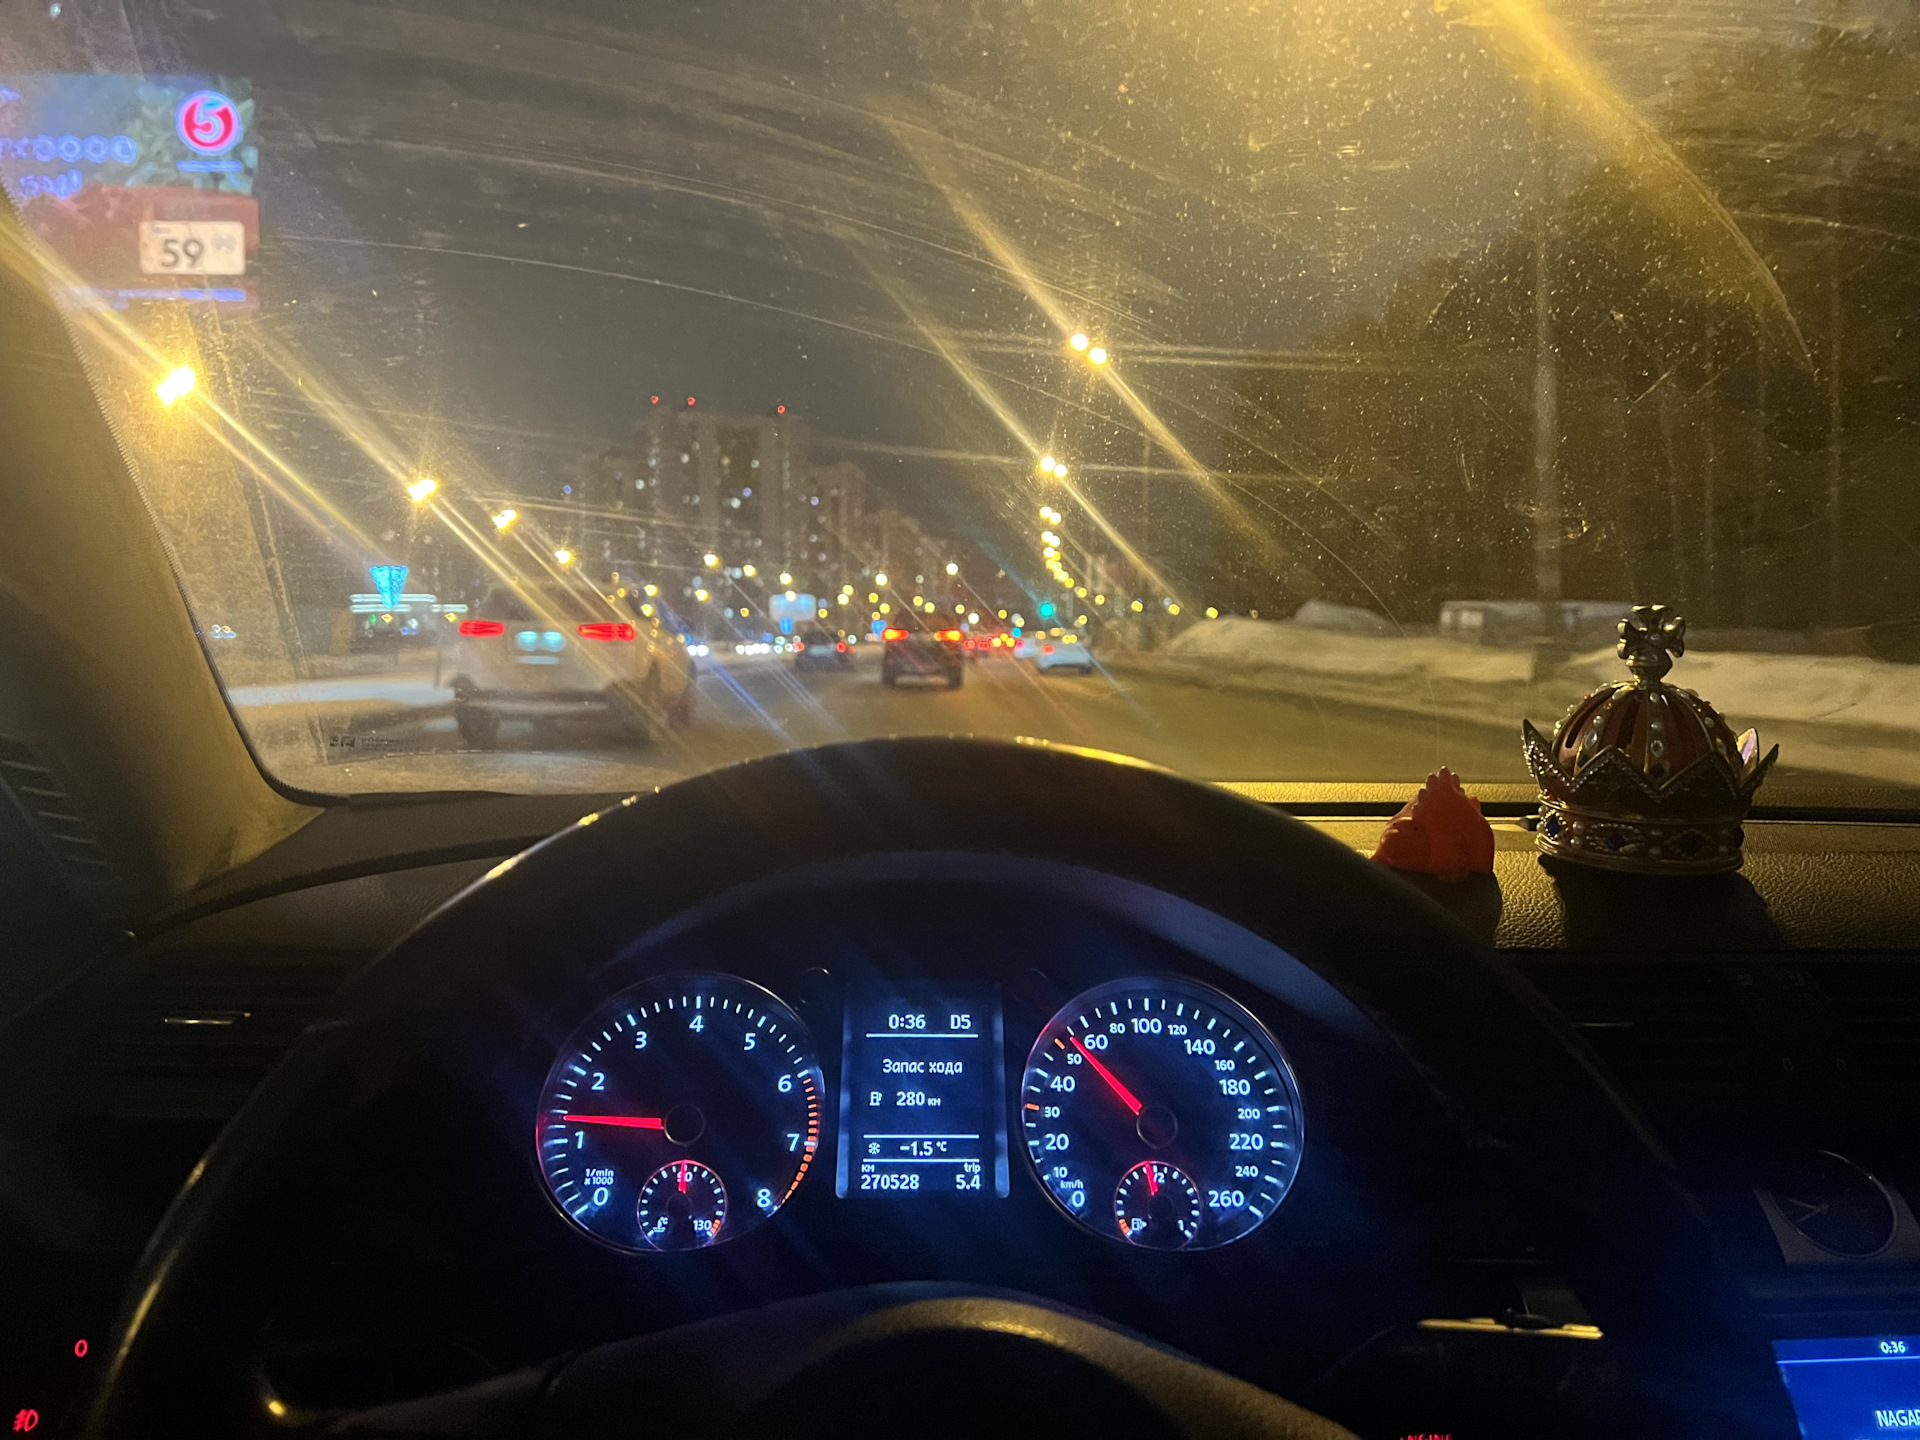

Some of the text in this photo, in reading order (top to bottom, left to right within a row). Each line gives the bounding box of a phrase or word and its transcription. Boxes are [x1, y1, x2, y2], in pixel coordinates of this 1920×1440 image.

[161, 239, 204, 268] 59
[689, 1015, 704, 1033] 4
[888, 1014, 972, 1030] 0:36 D5
[1110, 1022, 1126, 1035] 80
[1131, 1018, 1163, 1034] 100
[1168, 1024, 1188, 1036] 120
[635, 1031, 648, 1050] 3
[744, 1033, 757, 1051] 5
[1084, 1034, 1109, 1051] 60
[1184, 1038, 1216, 1056] 140
[882, 1058, 963, 1075] Запас хода
[1067, 1053, 1083, 1066] 50
[1215, 1060, 1236, 1072] 160
[592, 1072, 605, 1091] 2
[778, 1074, 792, 1093] 6
[1050, 1075, 1076, 1093] 40
[1219, 1079, 1251, 1096] 180
[896, 1091, 926, 1107] 280
[1044, 1106, 1061, 1119] 30
[1237, 1108, 1261, 1120] 200
[575, 1131, 584, 1149] 1
[787, 1133, 800, 1152] 7
[1045, 1133, 1070, 1150] 20
[1229, 1133, 1264, 1151] 220
[584, 1168, 615, 1178] 1/min
[963, 1163, 982, 1175] trip
[1053, 1167, 1068, 1179] 10
[1235, 1166, 1259, 1178] 240
[860, 1174, 920, 1190] 270528
[955, 1174, 982, 1190] 5.4
[1060, 1178, 1084, 1191] km/h
[593, 1187, 609, 1206] 0
[756, 1188, 771, 1208] 8
[1071, 1190, 1085, 1208] 0
[1208, 1190, 1245, 1208] 260
[693, 1219, 713, 1231] 130
[1177, 1219, 1185, 1232] 1
[1880, 1341, 1906, 1354] 0:36
